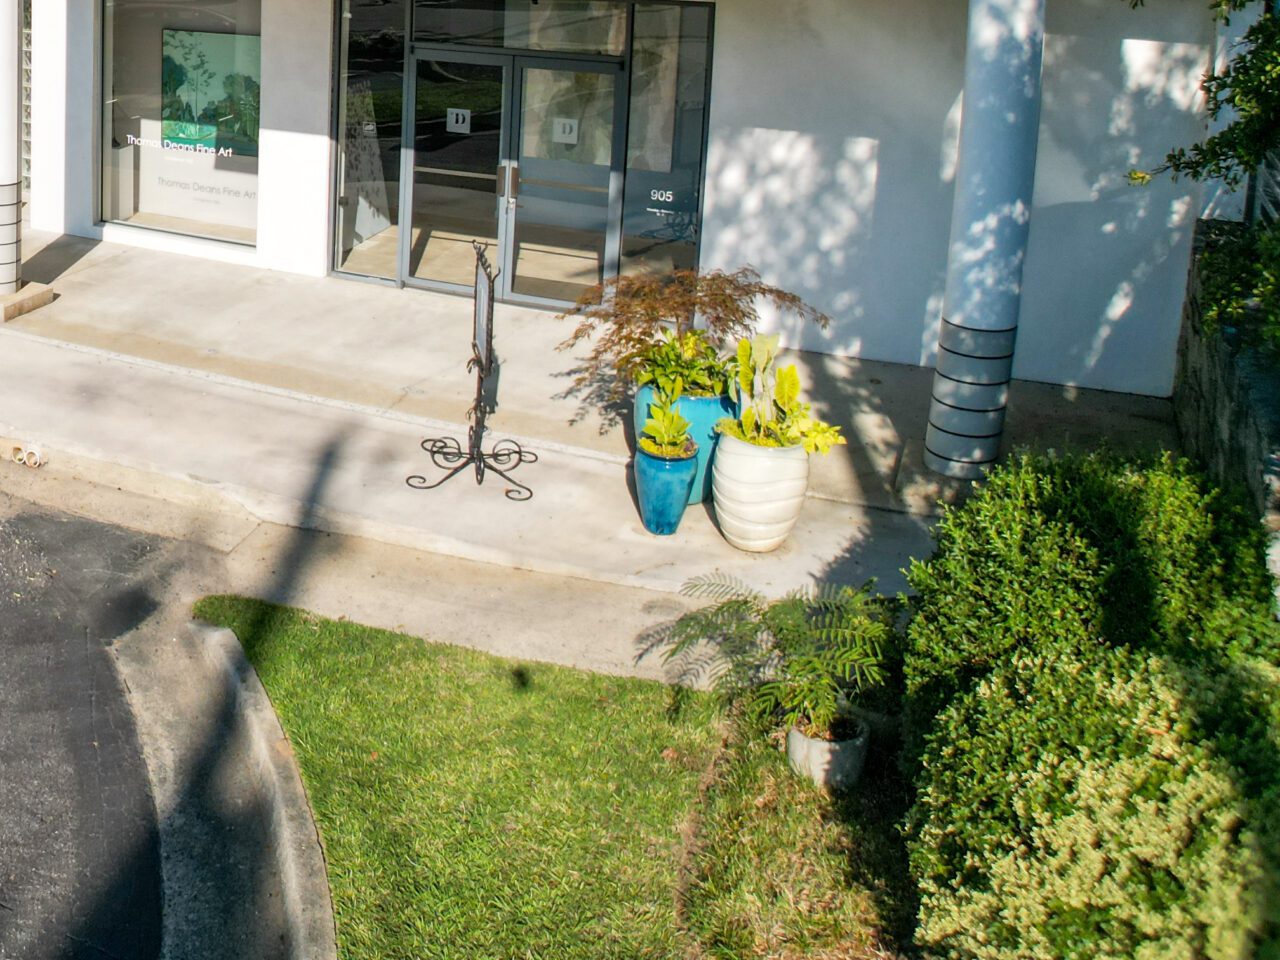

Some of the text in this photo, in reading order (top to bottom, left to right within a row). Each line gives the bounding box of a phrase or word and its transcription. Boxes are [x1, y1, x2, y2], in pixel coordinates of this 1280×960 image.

[126, 134, 233, 158] Thomas Deans Fine Art
[650, 189, 674, 202] 905
